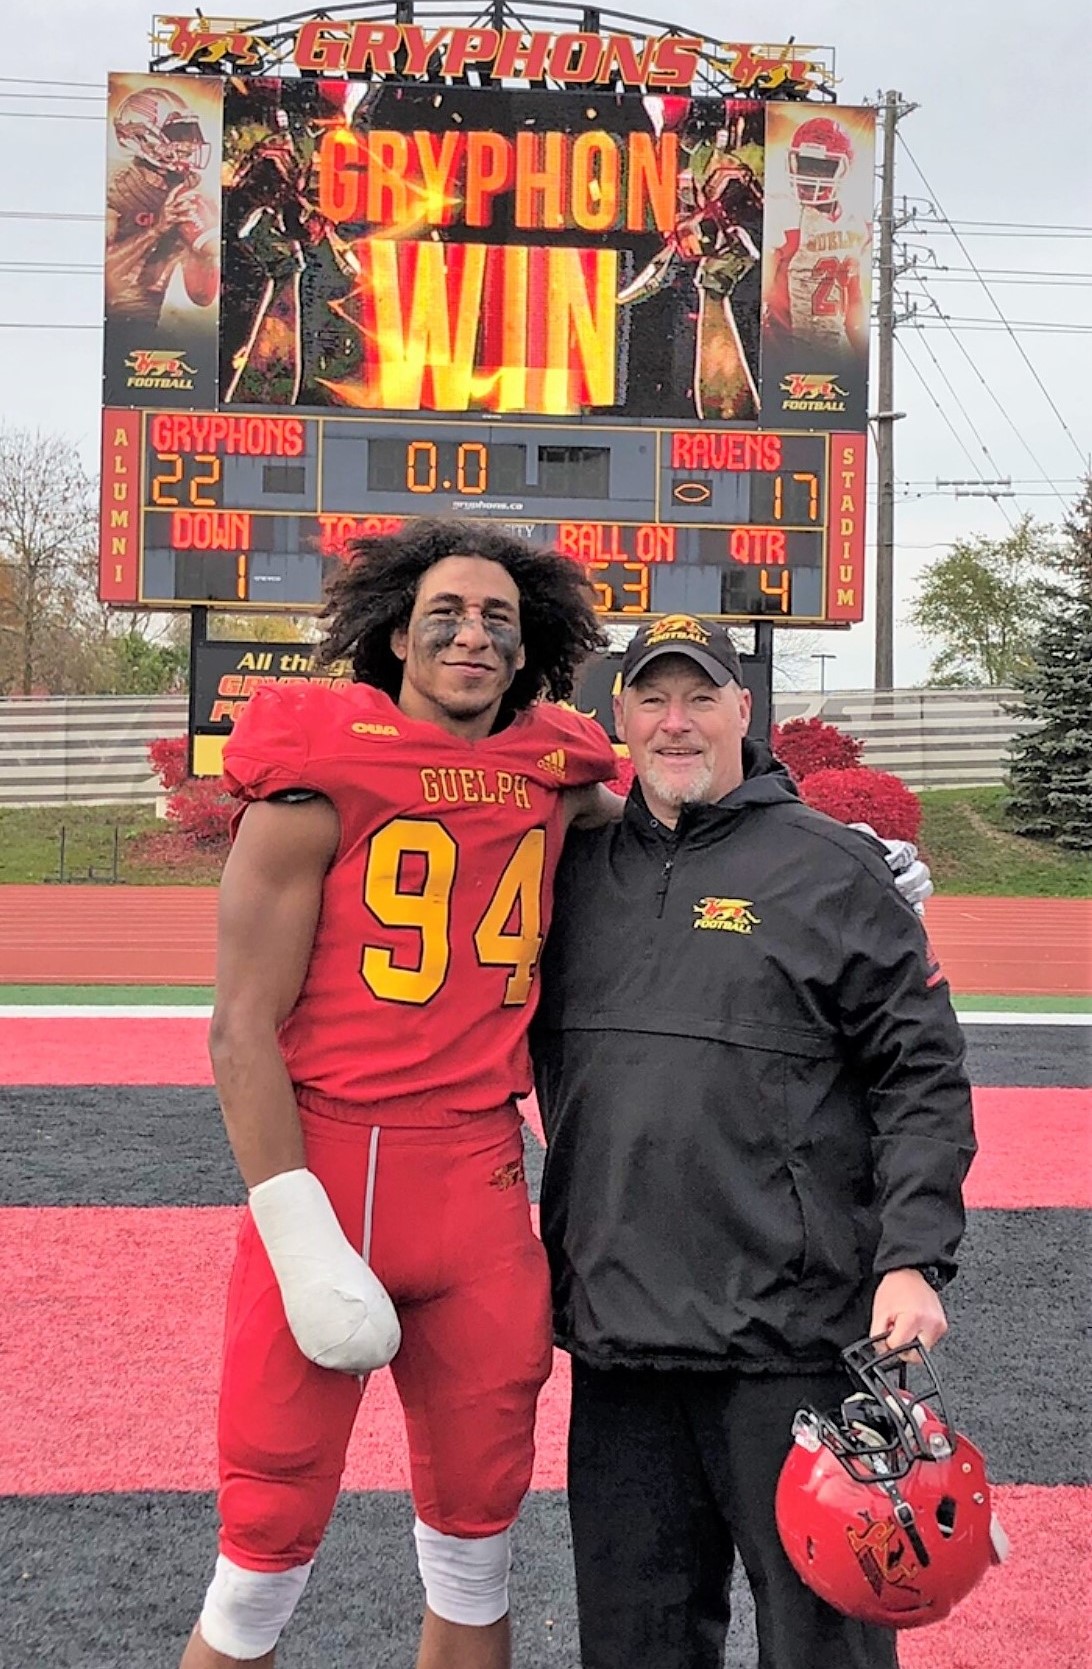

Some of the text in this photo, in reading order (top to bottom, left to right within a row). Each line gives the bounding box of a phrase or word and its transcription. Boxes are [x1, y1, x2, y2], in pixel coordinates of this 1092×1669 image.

[294, 21, 703, 87] GRYPHONS
[317, 129, 678, 233] GRYPHON
[360, 239, 618, 413] WIN
[126, 377, 194, 390] FOOTBALL
[782, 399, 845, 412] FOOTBALL
[153, 416, 304, 457] GRYPHONS
[672, 433, 782, 472] RAVENS
[152, 453, 220, 506] 22
[406, 441, 487, 495] 0.0
[110, 427, 129, 582] ALUMNI
[774, 473, 819, 521] 17
[173, 513, 251, 550] DOWN
[637, 526, 675, 562] ON
[730, 528, 787, 565] QTR
[836, 447, 855, 607] STADIUM
[237, 554, 246, 599] 1
[760, 569, 790, 613] 4
[644, 631, 710, 646] FOOTBALL
[236, 652, 273, 671] All
[351, 722, 399, 736] OUA
[420, 767, 532, 809] GUELPH
[360, 816, 545, 1007] 94
[693, 919, 753, 935] FOOTBALL
